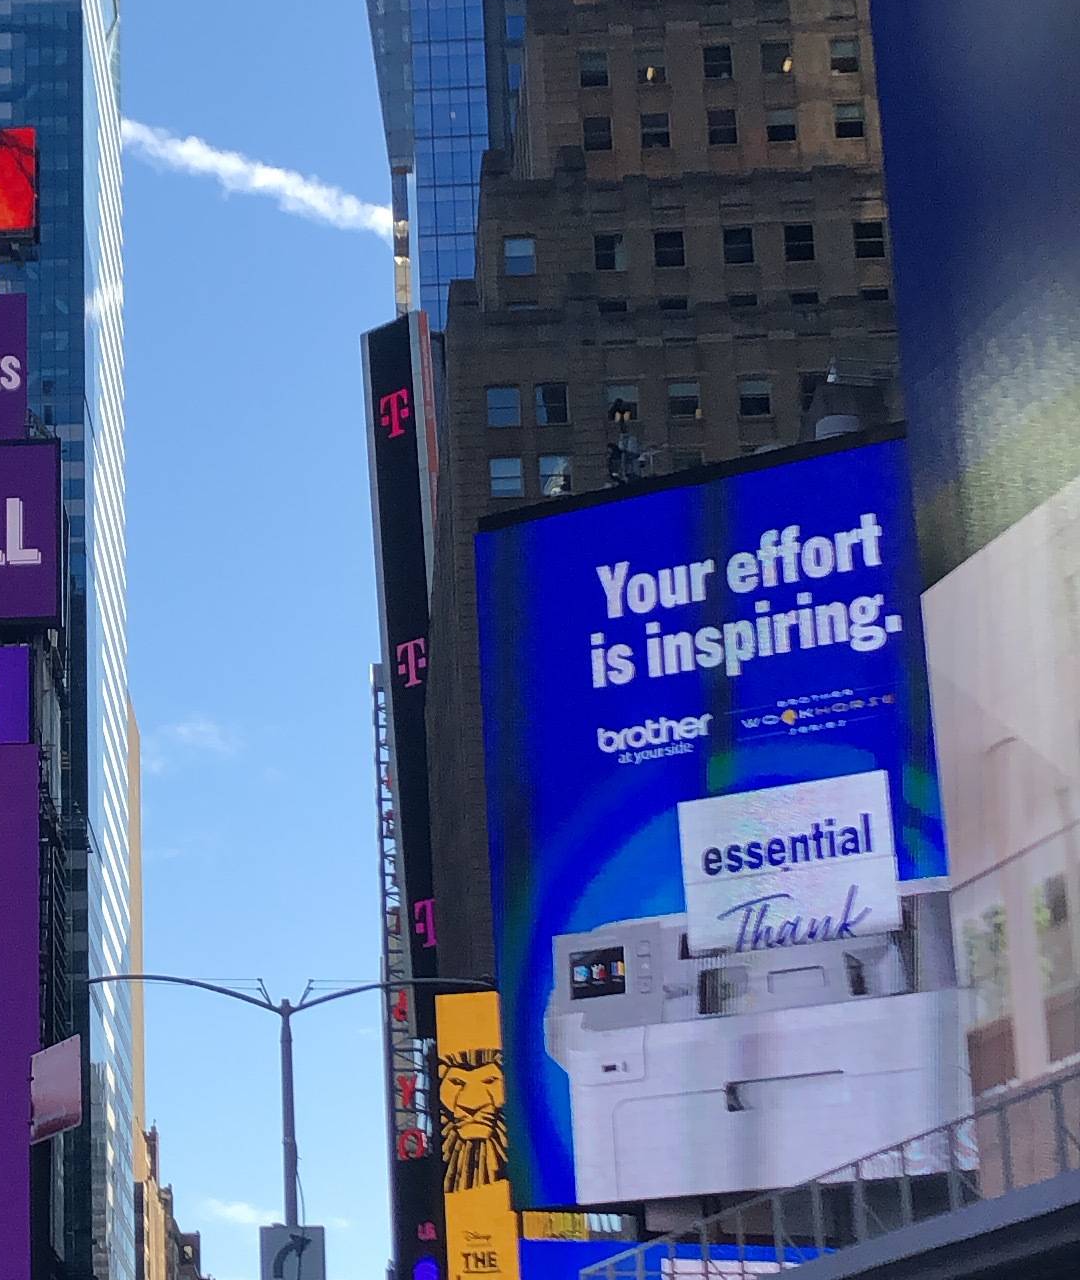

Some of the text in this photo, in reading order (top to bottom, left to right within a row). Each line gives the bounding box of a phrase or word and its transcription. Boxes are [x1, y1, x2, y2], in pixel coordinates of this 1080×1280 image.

[596, 512, 883, 619] Your effort
[590, 591, 903, 689] is inspiring.
[596, 712, 714, 754] brother
[740, 694, 894, 729] WOKHORSE
[701, 812, 874, 876] essential
[717, 883, 874, 954] Thank
[462, 1252, 497, 1269] THE
